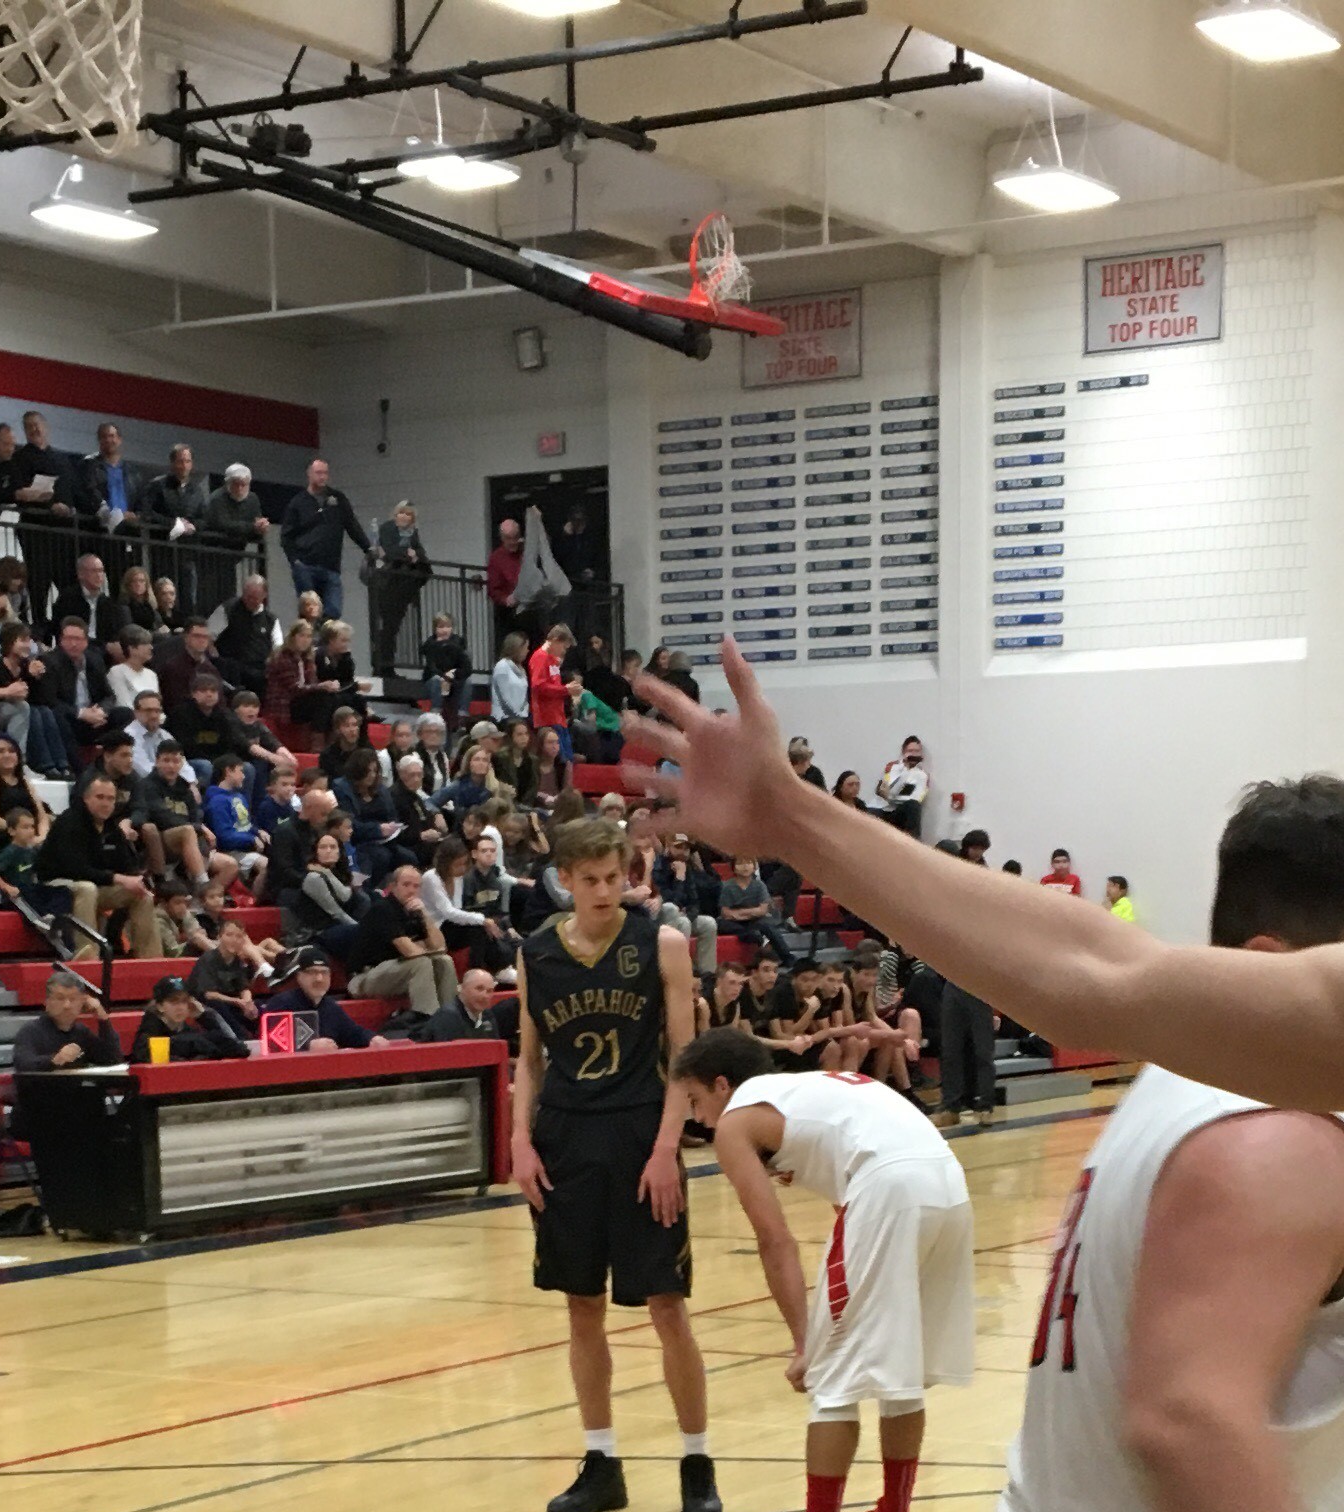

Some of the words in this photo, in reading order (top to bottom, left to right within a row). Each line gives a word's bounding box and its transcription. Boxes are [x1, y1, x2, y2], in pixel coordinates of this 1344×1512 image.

[1101, 253, 1205, 297] HERITAGE
[1127, 294, 1180, 318] STATE
[1108, 321, 1143, 343] TOP
[1149, 316, 1198, 339] FOUR
[765, 359, 793, 380] TOP
[797, 355, 838, 377] FOUR
[616, 944, 642, 979] C
[542, 988, 648, 1033] ARAPAHOE
[572, 1028, 621, 1081] 21
